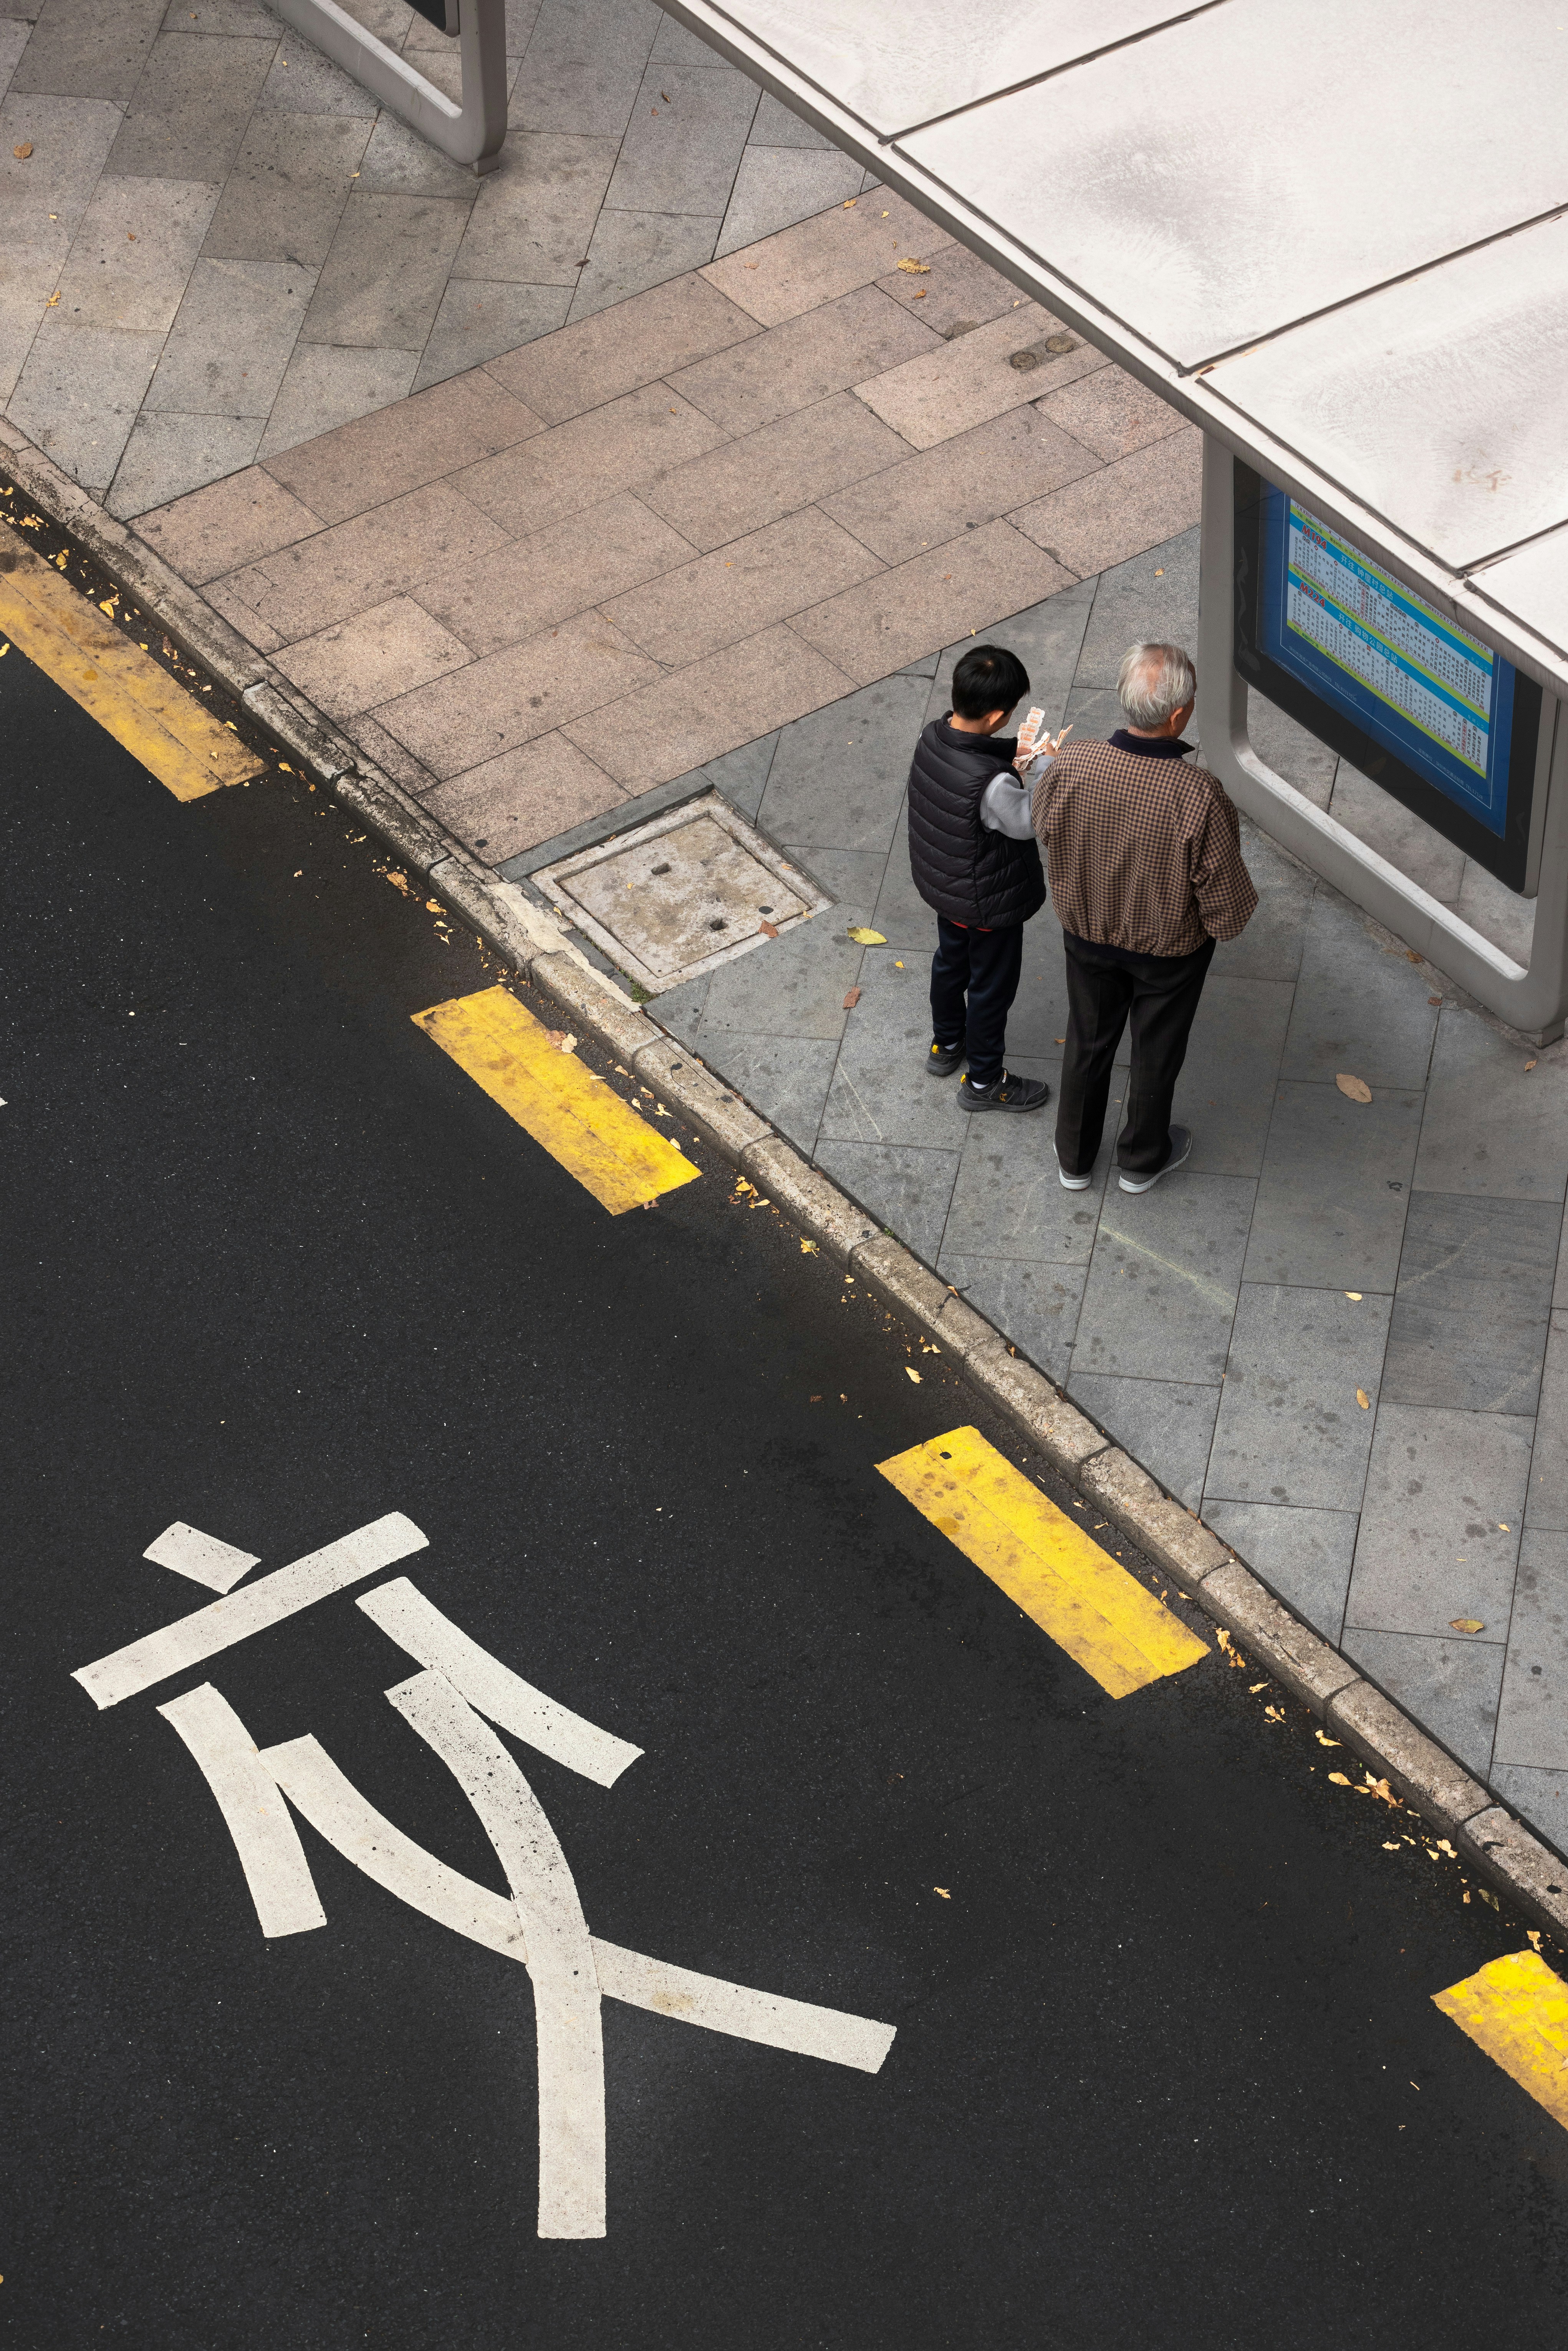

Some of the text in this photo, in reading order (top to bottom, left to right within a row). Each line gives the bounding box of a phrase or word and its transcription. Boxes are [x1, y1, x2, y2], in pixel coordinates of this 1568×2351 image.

[1301, 524, 1327, 550] M194
[1341, 554, 1393, 601] 开往 钟屋村总站
[1300, 581, 1325, 608] M224
[1338, 611, 1351, 629] 开往
[1354, 624, 1397, 665] 购物公园总站
[1426, 637, 1430, 664] 河东
